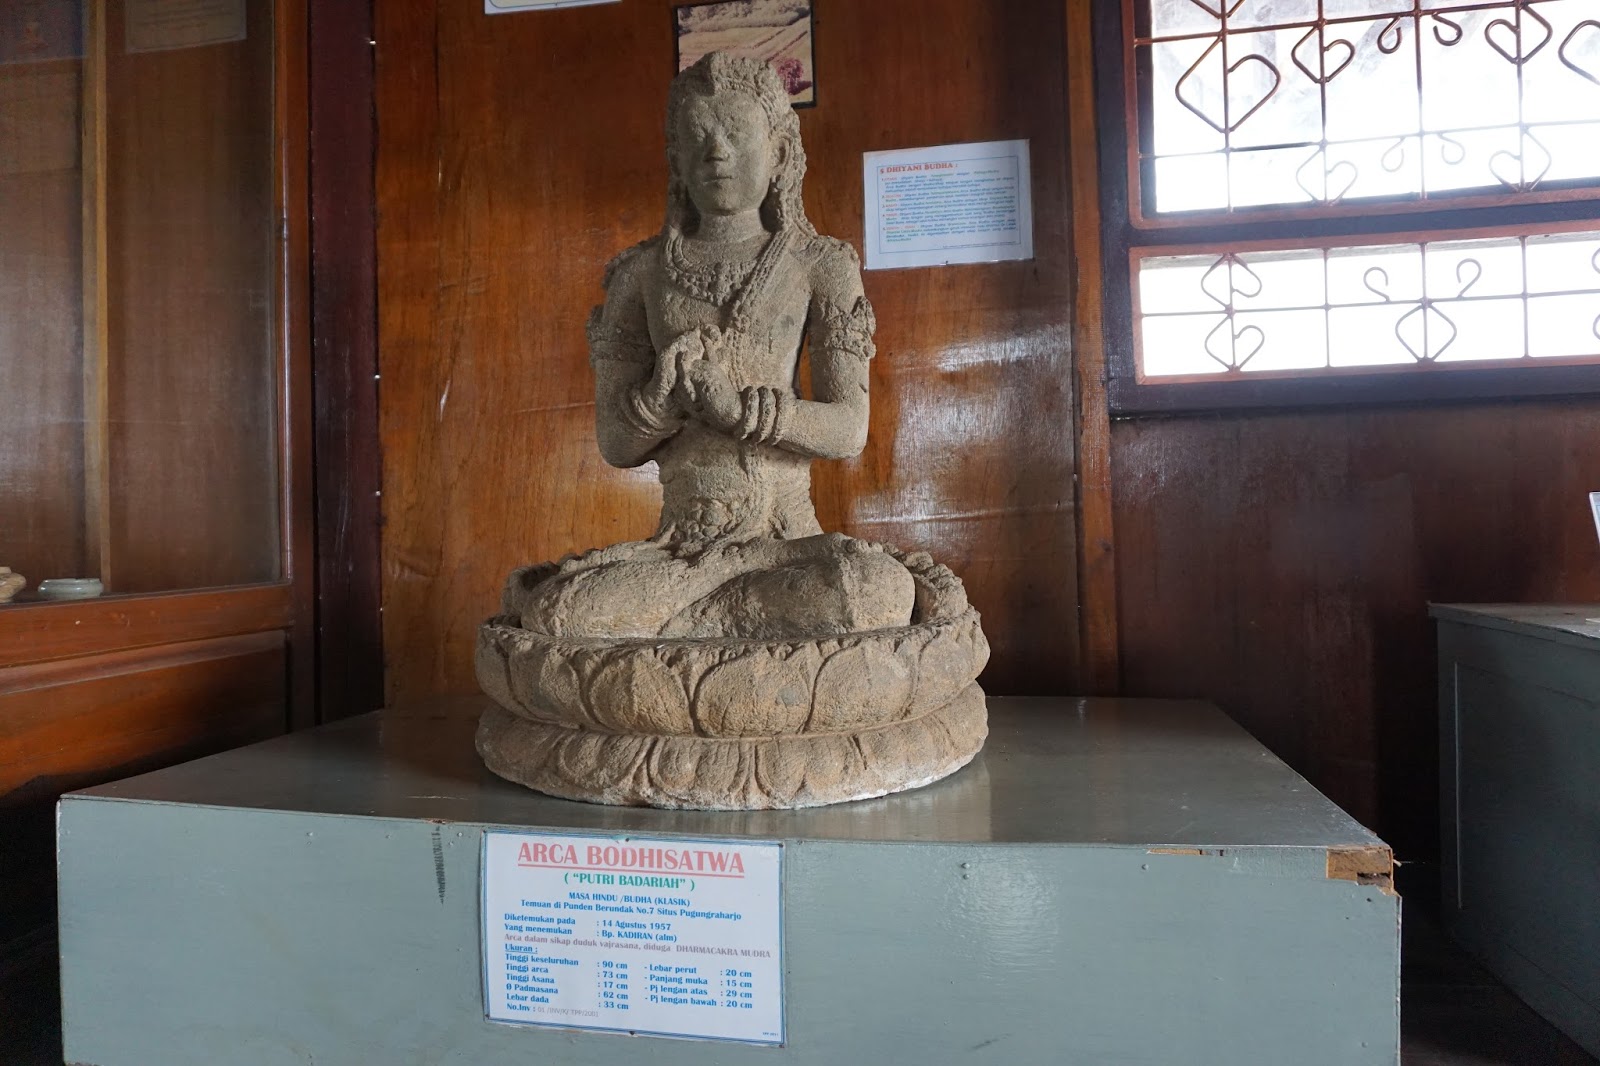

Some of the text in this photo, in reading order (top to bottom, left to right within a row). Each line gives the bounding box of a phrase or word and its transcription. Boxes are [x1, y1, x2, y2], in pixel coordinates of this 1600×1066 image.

[518, 842, 744, 873] ARCA BODHISATWA
[620, 895, 651, 903] /BUDHA
[654, 898, 690, 907] (KLASIK)
[521, 900, 551, 908] Temuan
[596, 904, 633, 913] Berundak
[680, 910, 741, 921] Pugungraharjo
[505, 914, 554, 923] Diketemukan
[557, 916, 575, 925] pada
[615, 921, 646, 929] Agustus
[505, 924, 523, 933] Yang
[526, 926, 572, 934] menemukan
[602, 930, 614, 938] Bp.
[618, 932, 653, 940] KADIRAN
[656, 933, 677, 942] (alm)
[505, 944, 532, 952] Ukuran
[525, 935, 547, 943] dalam
[550, 936, 570, 946] sikap
[573, 938, 597, 947] duduk
[600, 940, 640, 950] vajrasana,
[644, 943, 671, 952] diduga
[676, 945, 738, 956] DHARMACAKRA
[741, 949, 770, 958] MUDRA
[506, 954, 528, 962] Tinggi
[531, 956, 578, 966] keseluruhan
[506, 964, 528, 972] Tinggi
[675, 966, 697, 974] perut
[507, 974, 529, 982] Tinggi
[650, 974, 682, 984] Panjang
[514, 984, 558, 994] Padmasana
[650, 985, 658, 993] Pj
[661, 986, 687, 995] lengan
[650, 995, 658, 1003] Pj
[661, 996, 688, 1005] lengan
[507, 1003, 530, 1012] No.Inv
